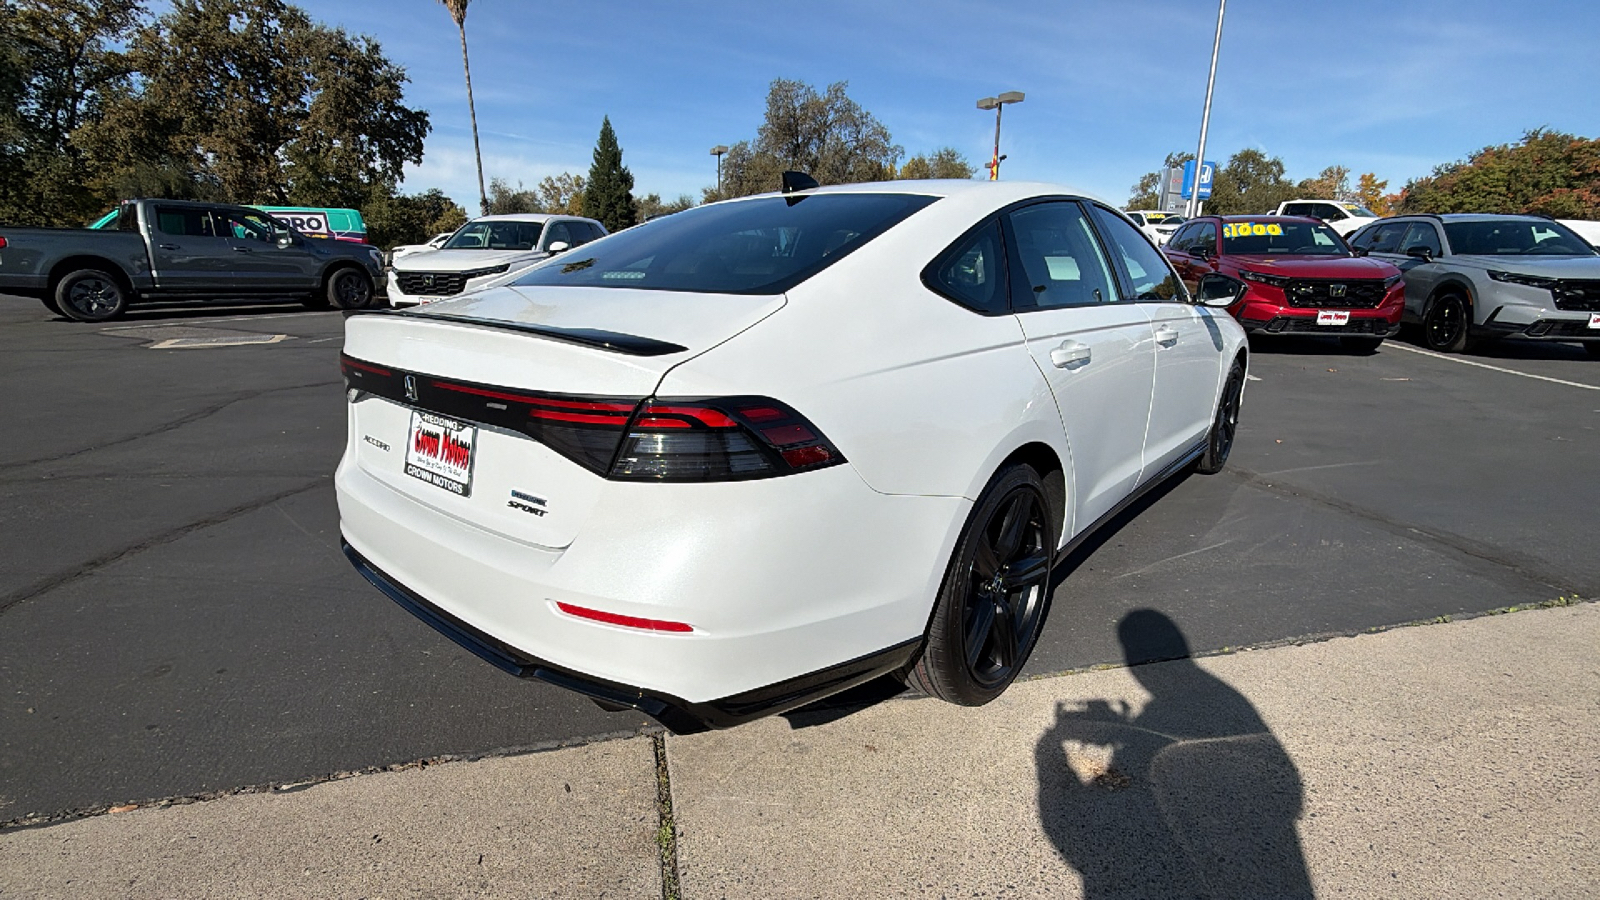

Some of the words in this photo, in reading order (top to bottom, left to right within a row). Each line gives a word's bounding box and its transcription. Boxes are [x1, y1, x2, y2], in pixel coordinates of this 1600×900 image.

[1224, 223, 1282, 237] $1000
[424, 413, 458, 431] REDDING
[363, 434, 390, 452] ACCORD
[415, 427, 440, 459] Crown
[440, 427, 470, 470] Motors
[407, 465, 432, 484] CROWN
[432, 474, 463, 494] MOTORS
[507, 500, 549, 517] SPORT
